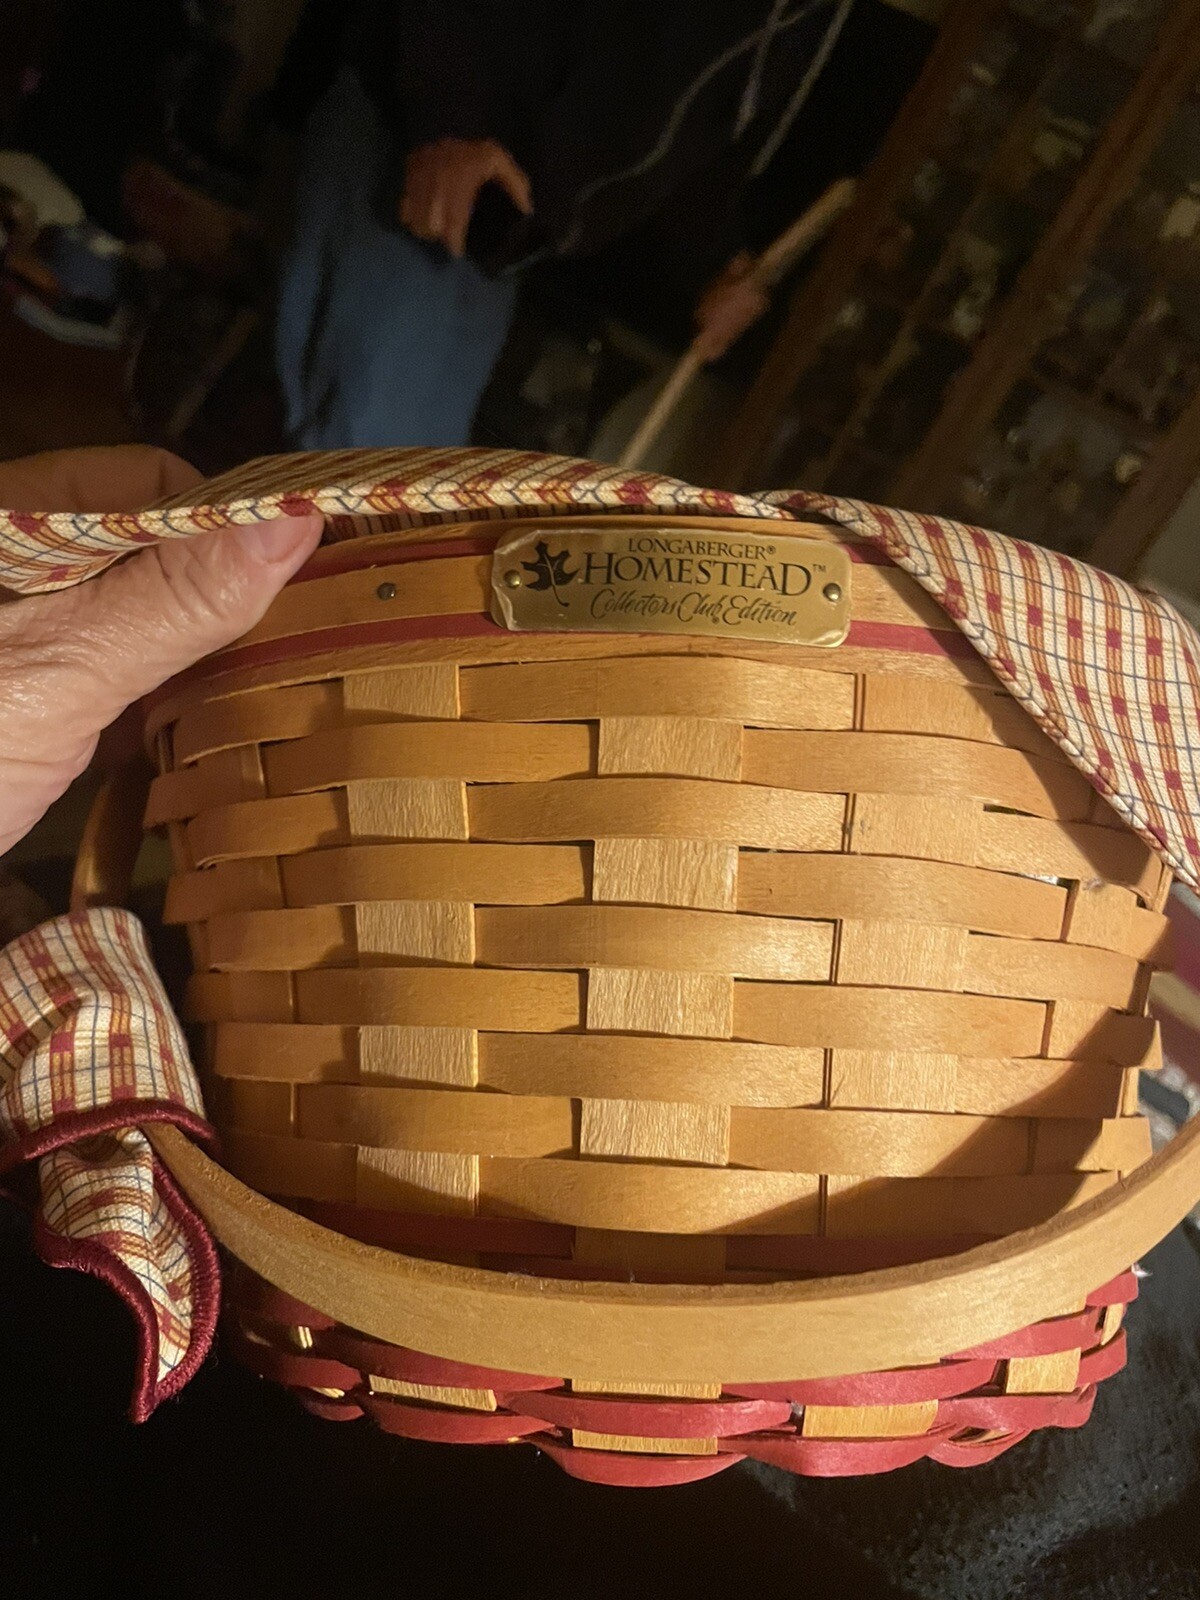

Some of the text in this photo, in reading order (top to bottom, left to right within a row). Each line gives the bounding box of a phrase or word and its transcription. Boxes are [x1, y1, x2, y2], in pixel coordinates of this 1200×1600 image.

[590, 588, 797, 626] Collectors Club Edition
